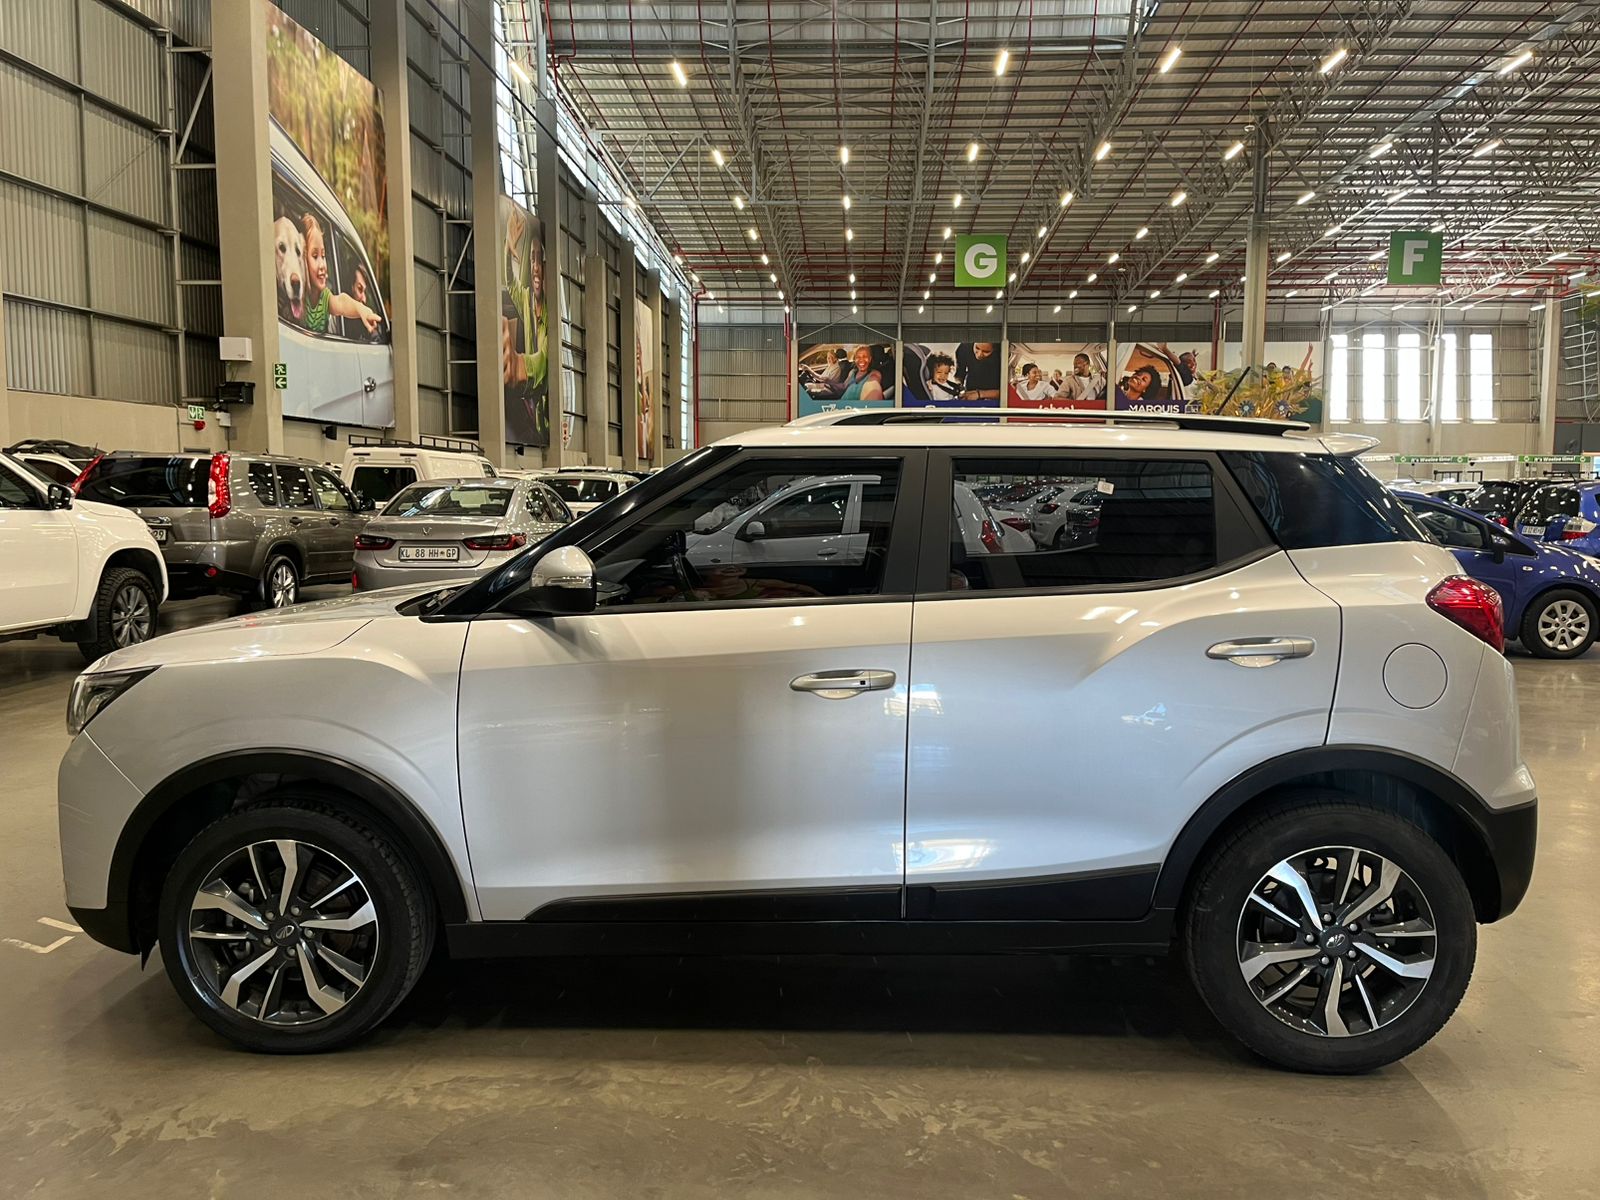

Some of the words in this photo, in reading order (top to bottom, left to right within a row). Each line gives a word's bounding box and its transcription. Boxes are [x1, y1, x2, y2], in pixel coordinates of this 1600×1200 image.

[964, 243, 998, 278] G
[1402, 240, 1429, 275] F
[1129, 404, 1180, 413] MARQUIS
[400, 549, 410, 557] KL
[415, 549, 425, 557] 88
[428, 549, 439, 557] HH
[446, 549, 456, 557] GP
